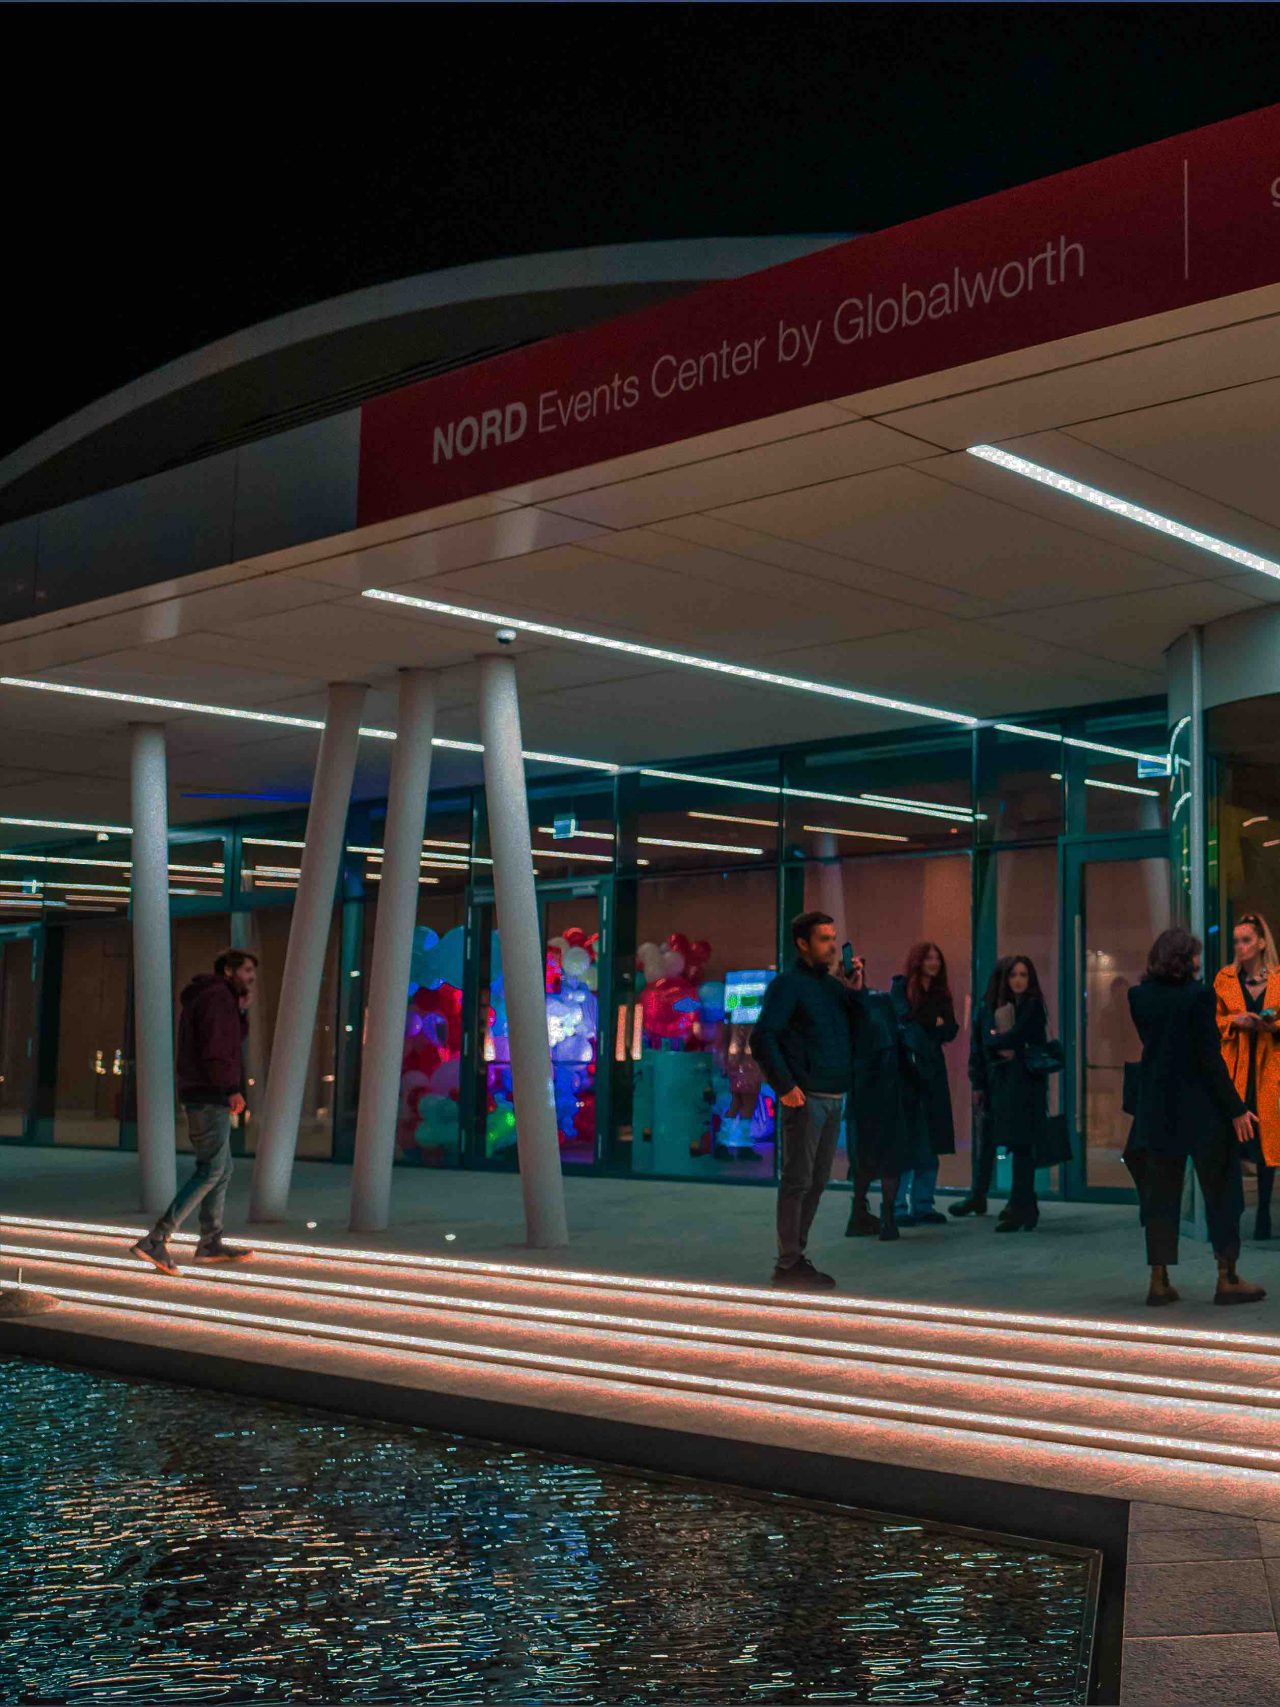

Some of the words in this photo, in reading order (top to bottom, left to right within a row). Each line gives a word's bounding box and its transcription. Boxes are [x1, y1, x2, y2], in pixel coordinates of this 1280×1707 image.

[432, 401, 528, 464] NORD
[538, 373, 640, 433] Events
[651, 336, 764, 399] Center
[778, 320, 822, 367] by
[833, 235, 1084, 345] Globalworth
